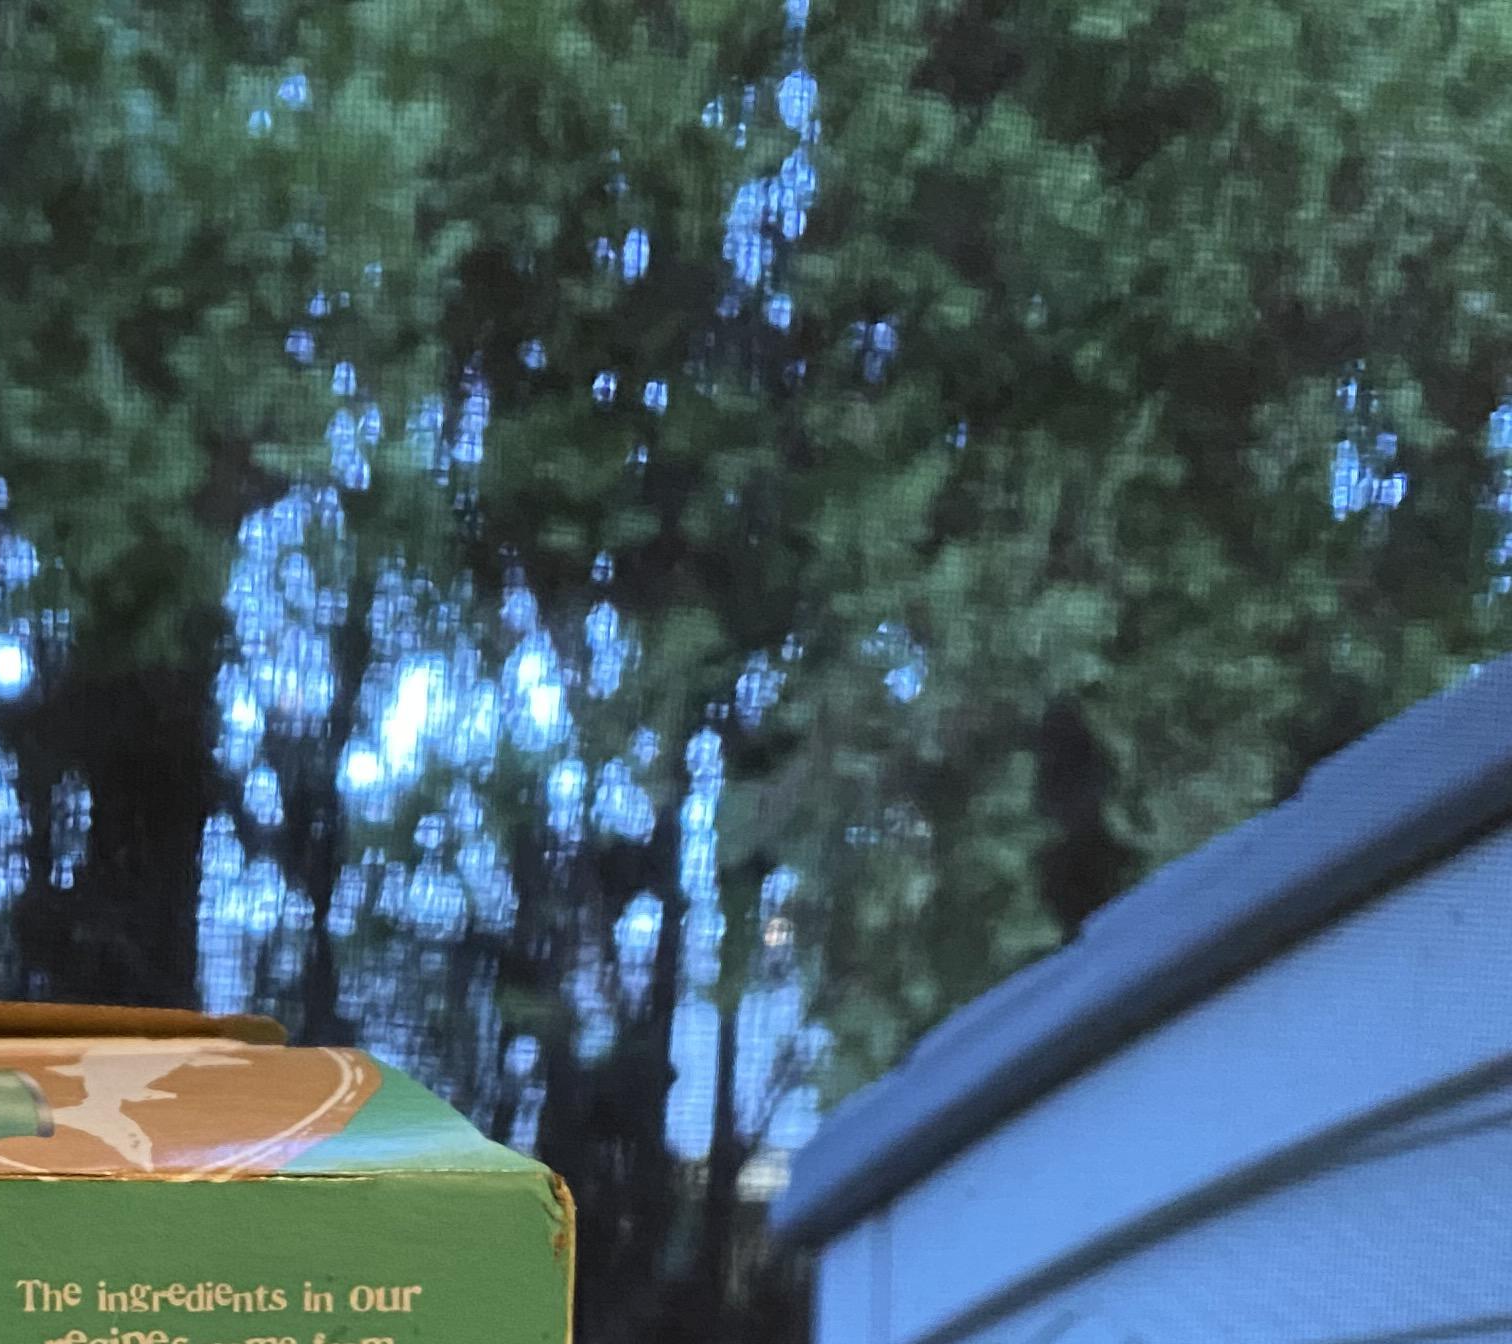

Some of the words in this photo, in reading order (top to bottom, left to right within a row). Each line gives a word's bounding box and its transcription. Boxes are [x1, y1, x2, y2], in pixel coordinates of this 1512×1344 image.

[17, 1279, 81, 1313] The
[98, 1281, 287, 1315] ingredients
[303, 1281, 333, 1312] in
[349, 1284, 422, 1313] our
